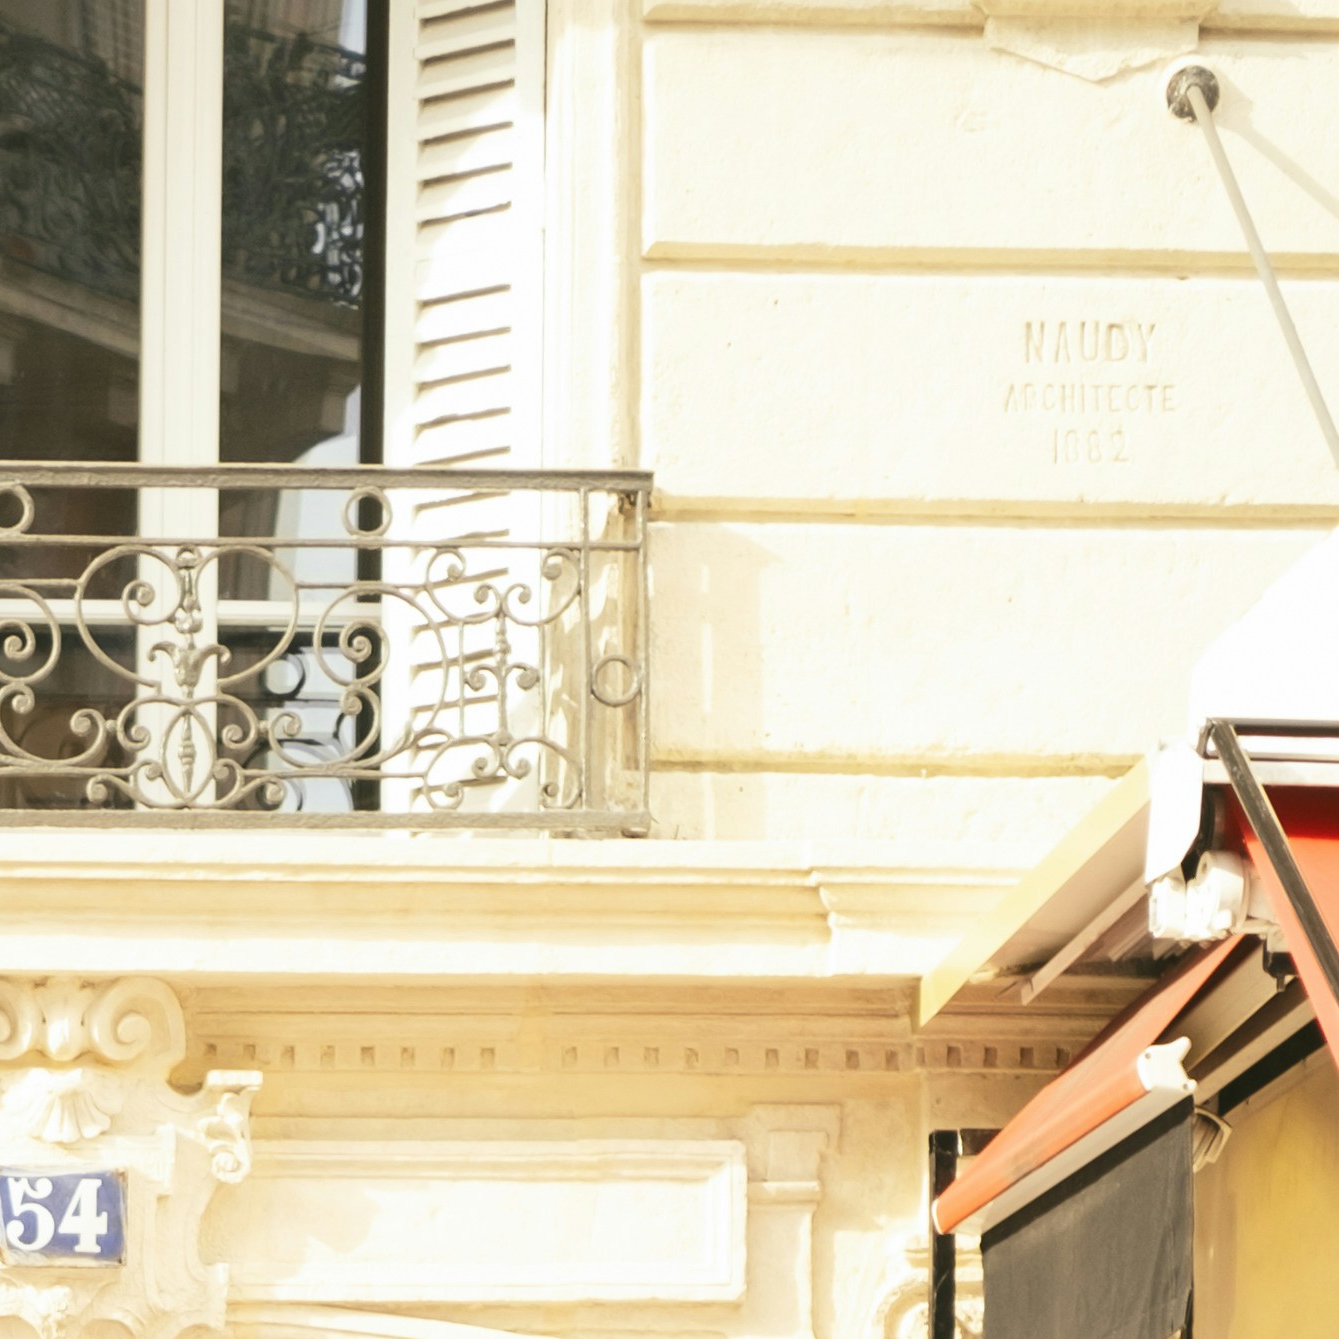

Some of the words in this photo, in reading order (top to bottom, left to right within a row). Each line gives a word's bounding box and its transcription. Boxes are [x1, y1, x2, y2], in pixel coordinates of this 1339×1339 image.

[1024, 320, 1157, 364] NAUDY
[1002, 383, 1178, 414] ARCHITECTE
[6, 1177, 108, 1253] 54
